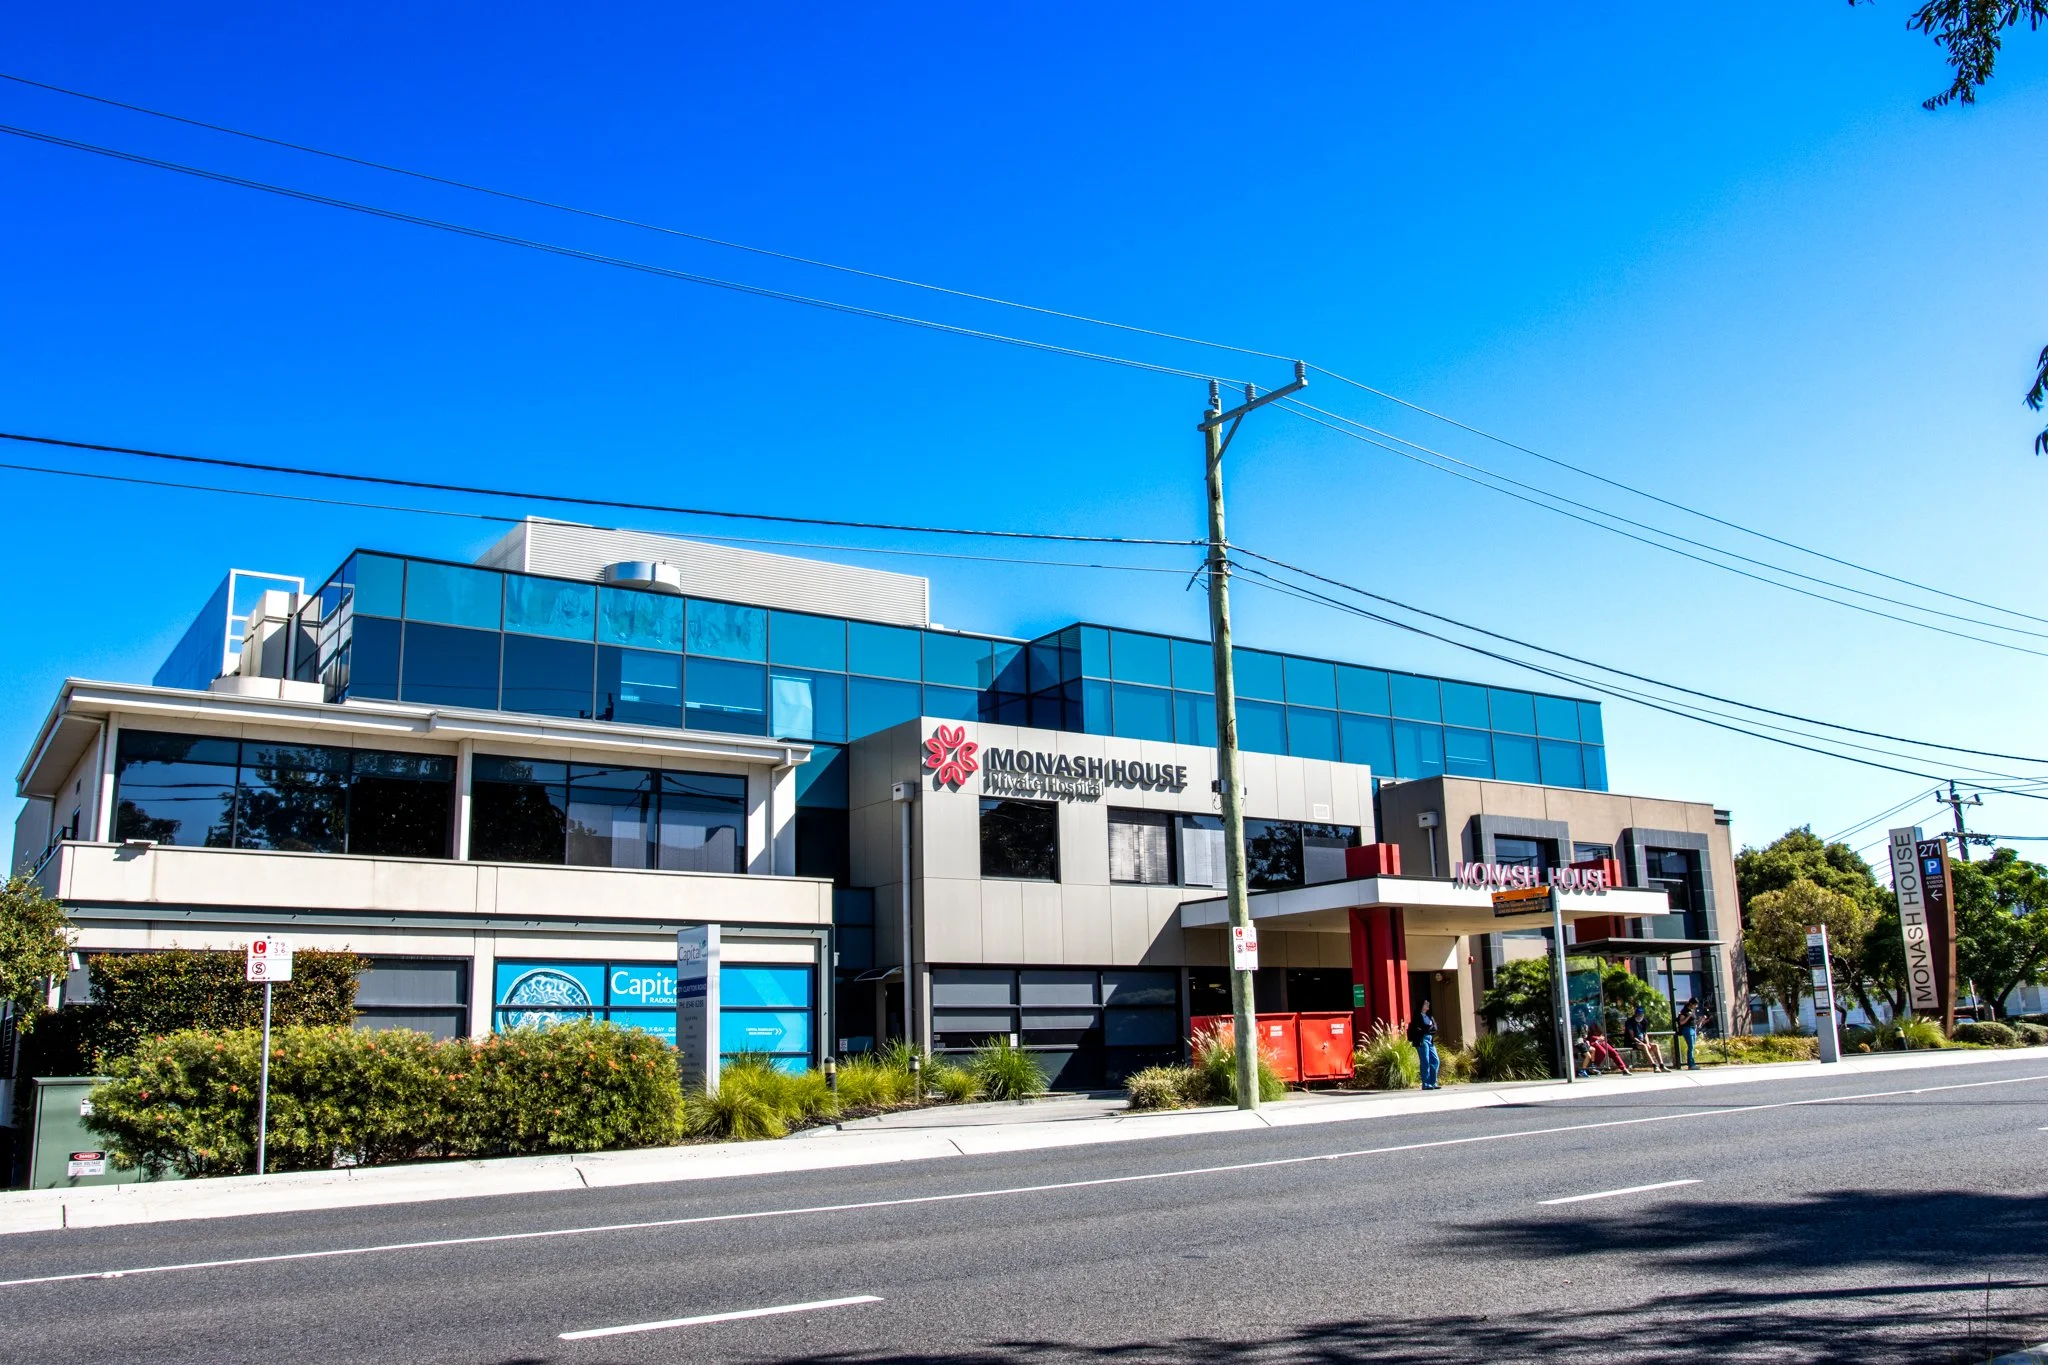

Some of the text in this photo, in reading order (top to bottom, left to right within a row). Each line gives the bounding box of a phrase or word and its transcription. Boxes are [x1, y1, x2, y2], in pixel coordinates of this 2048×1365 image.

[986, 747, 1188, 787] MONASH HOUSE
[988, 772, 1104, 797] Private Hospital
[1919, 843, 1941, 858] 271
[1456, 861, 1612, 891] MONASH HOUSE
[1927, 860, 1938, 873] P
[1895, 833, 1933, 1002] MONASH HOUSE
[255, 941, 264, 954] C
[678, 943, 701, 966] Capital
